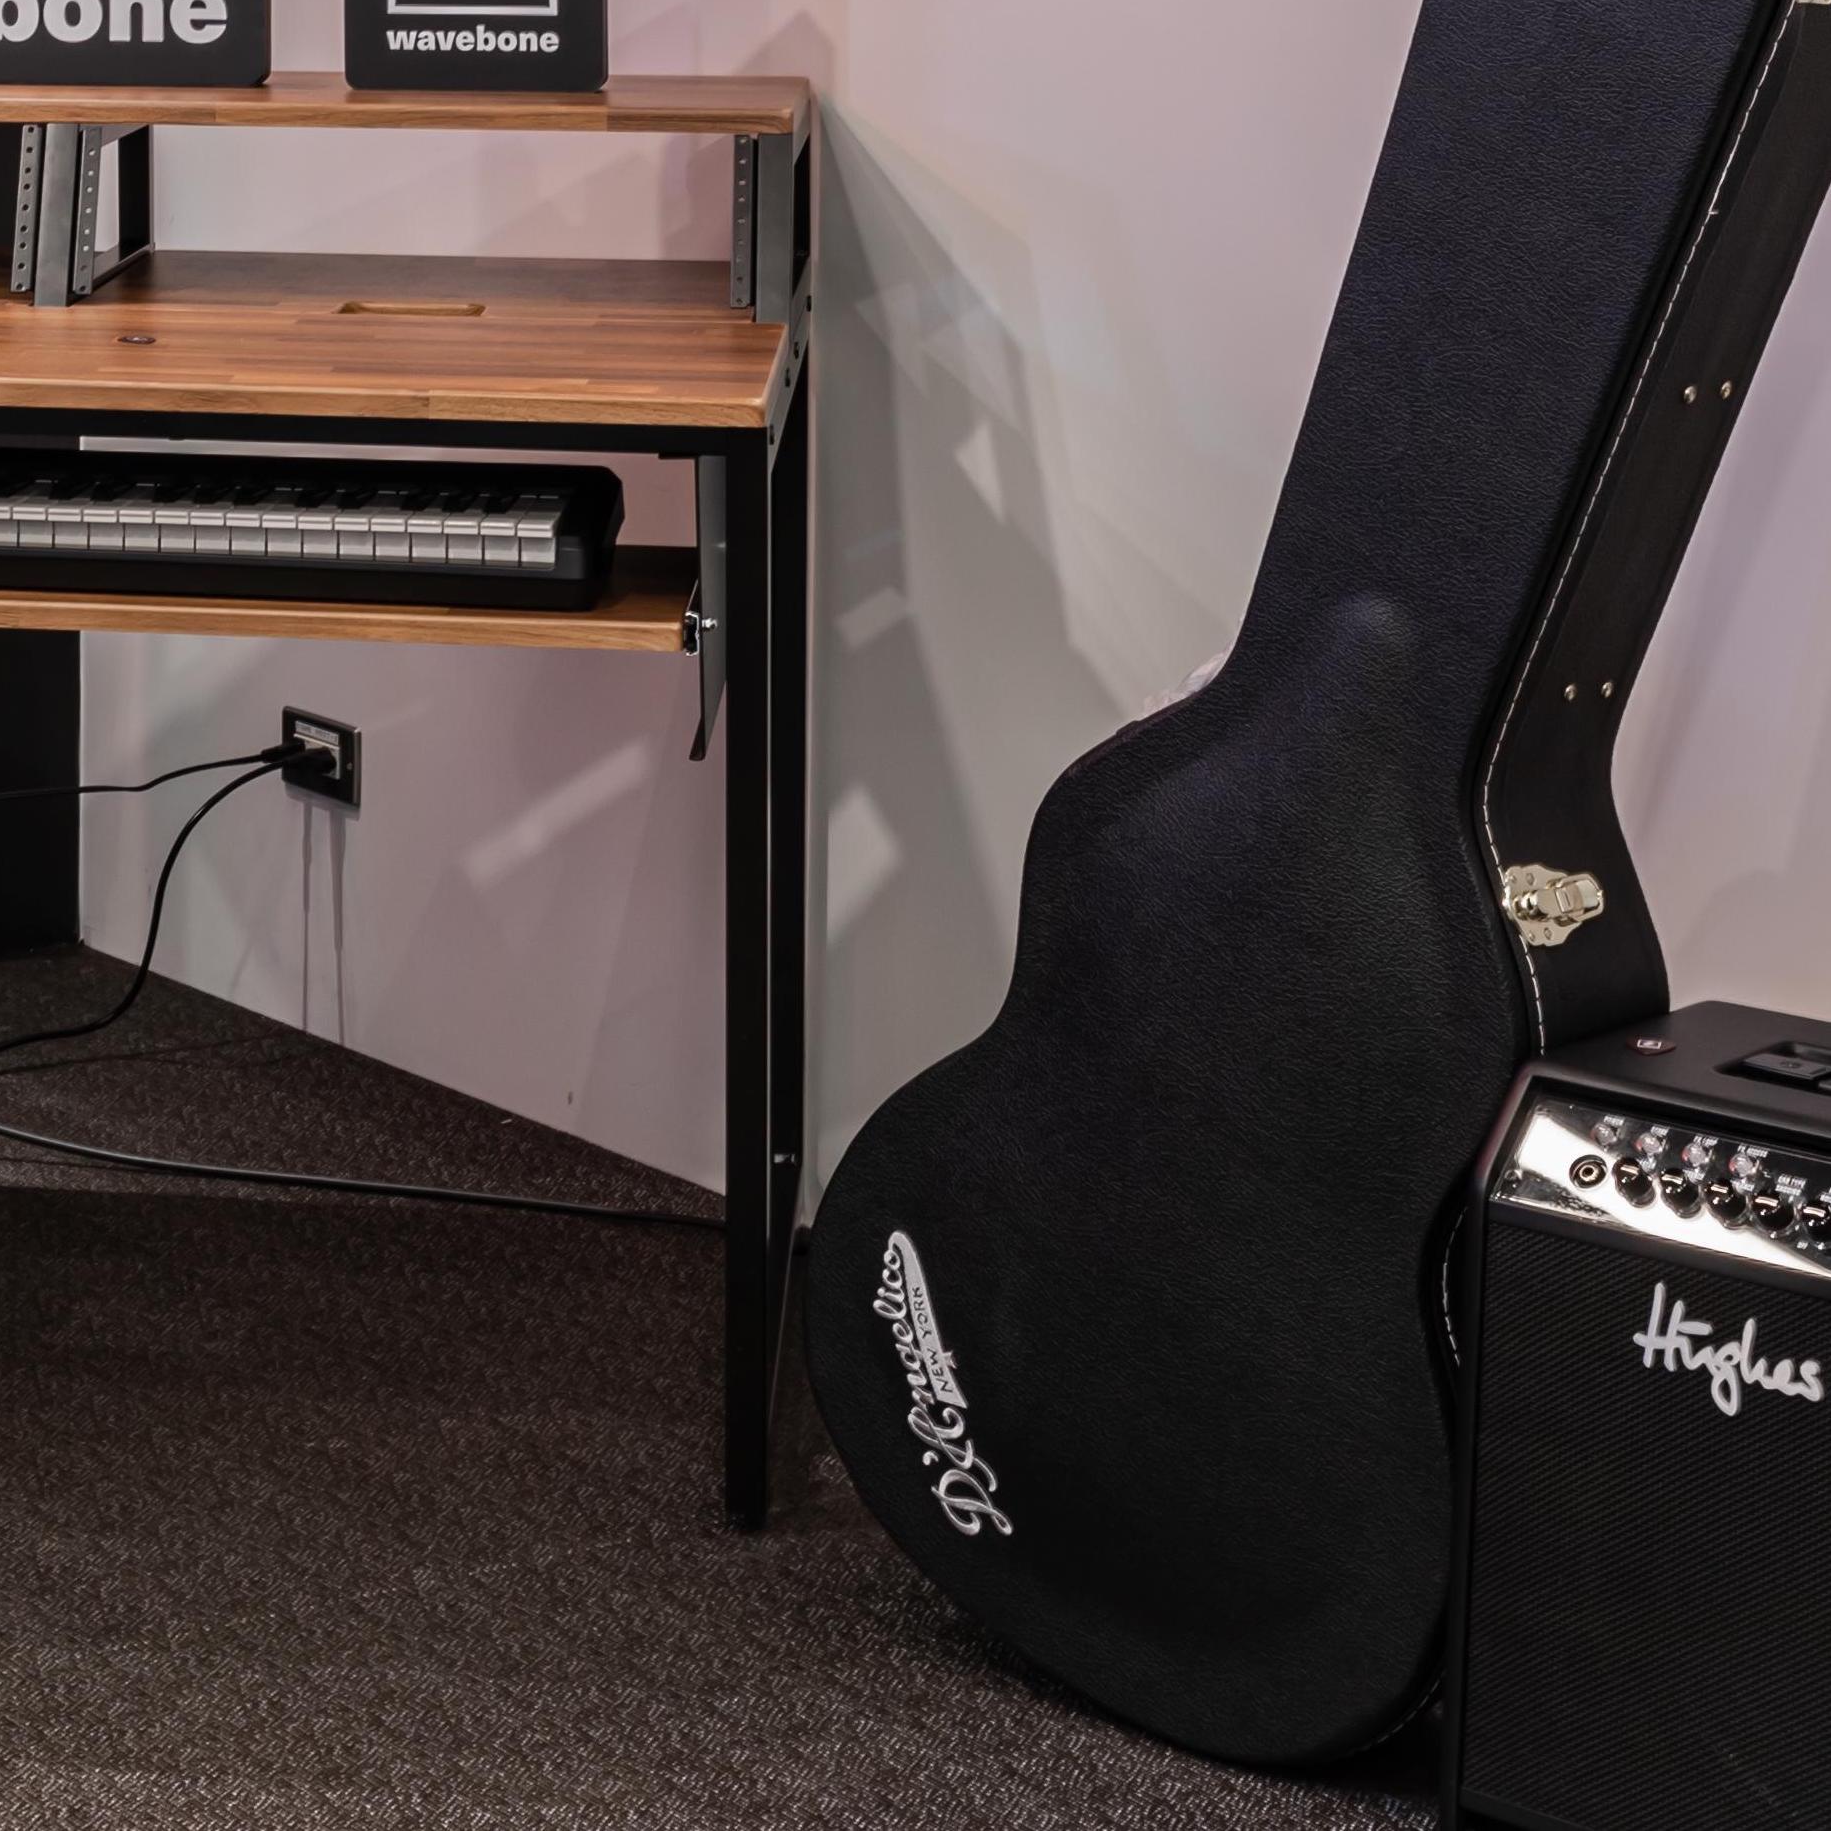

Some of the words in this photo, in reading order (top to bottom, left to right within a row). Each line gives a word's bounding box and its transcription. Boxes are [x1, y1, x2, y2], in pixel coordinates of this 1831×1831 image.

[385, 24, 560, 54] wavebone
[912, 1285, 935, 1340] YORK
[925, 1348, 955, 1395] NEW
[1632, 1281, 1826, 1418] Hughes
[872, 1242, 1014, 1537] D'Angelico
